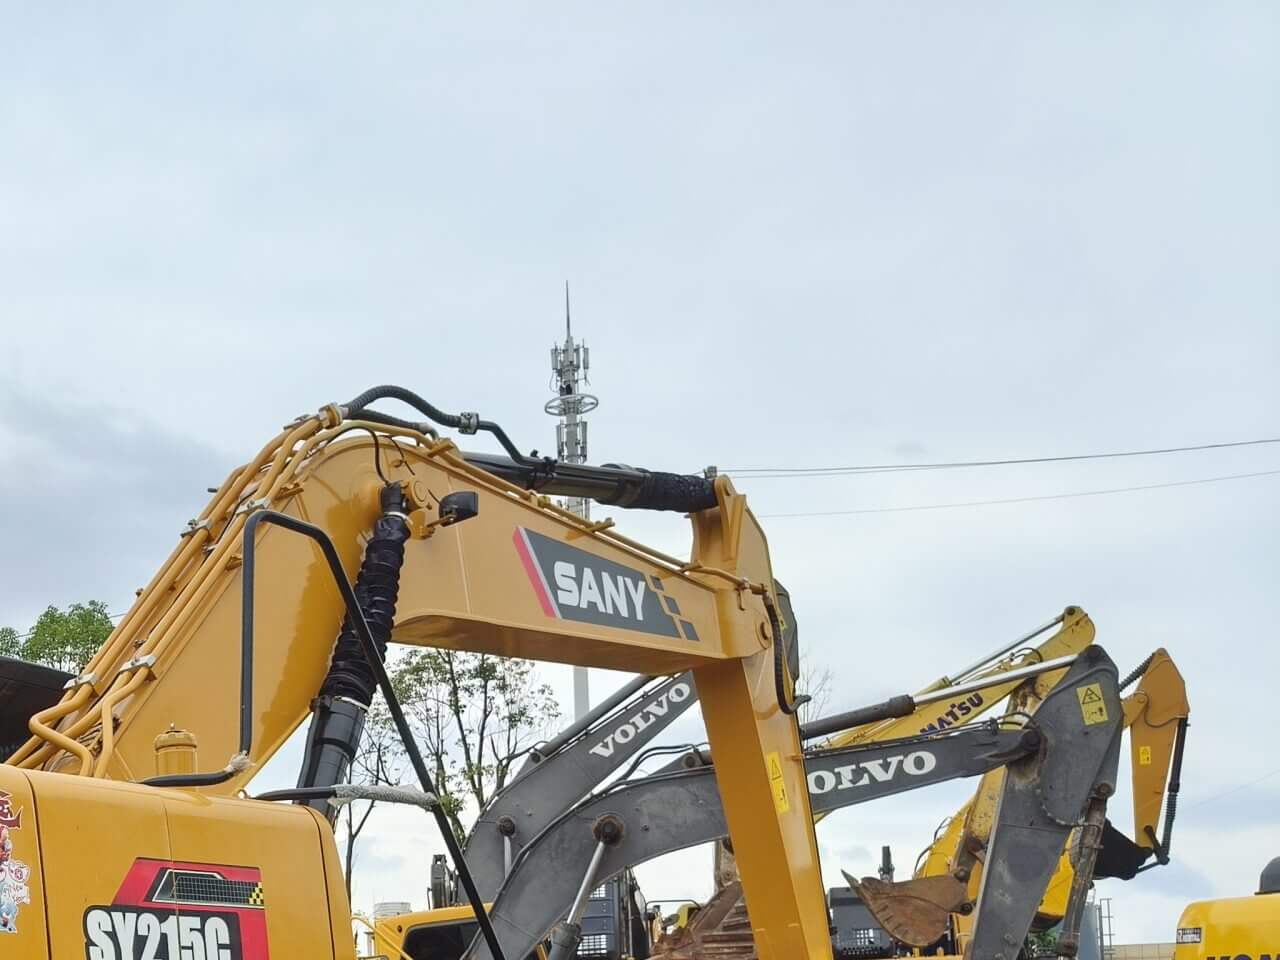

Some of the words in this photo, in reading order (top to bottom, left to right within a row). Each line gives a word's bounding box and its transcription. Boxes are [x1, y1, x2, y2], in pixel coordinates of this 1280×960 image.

[553, 561, 646, 621] SANY
[590, 681, 691, 758] VOLVO
[807, 751, 937, 794] OLVO
